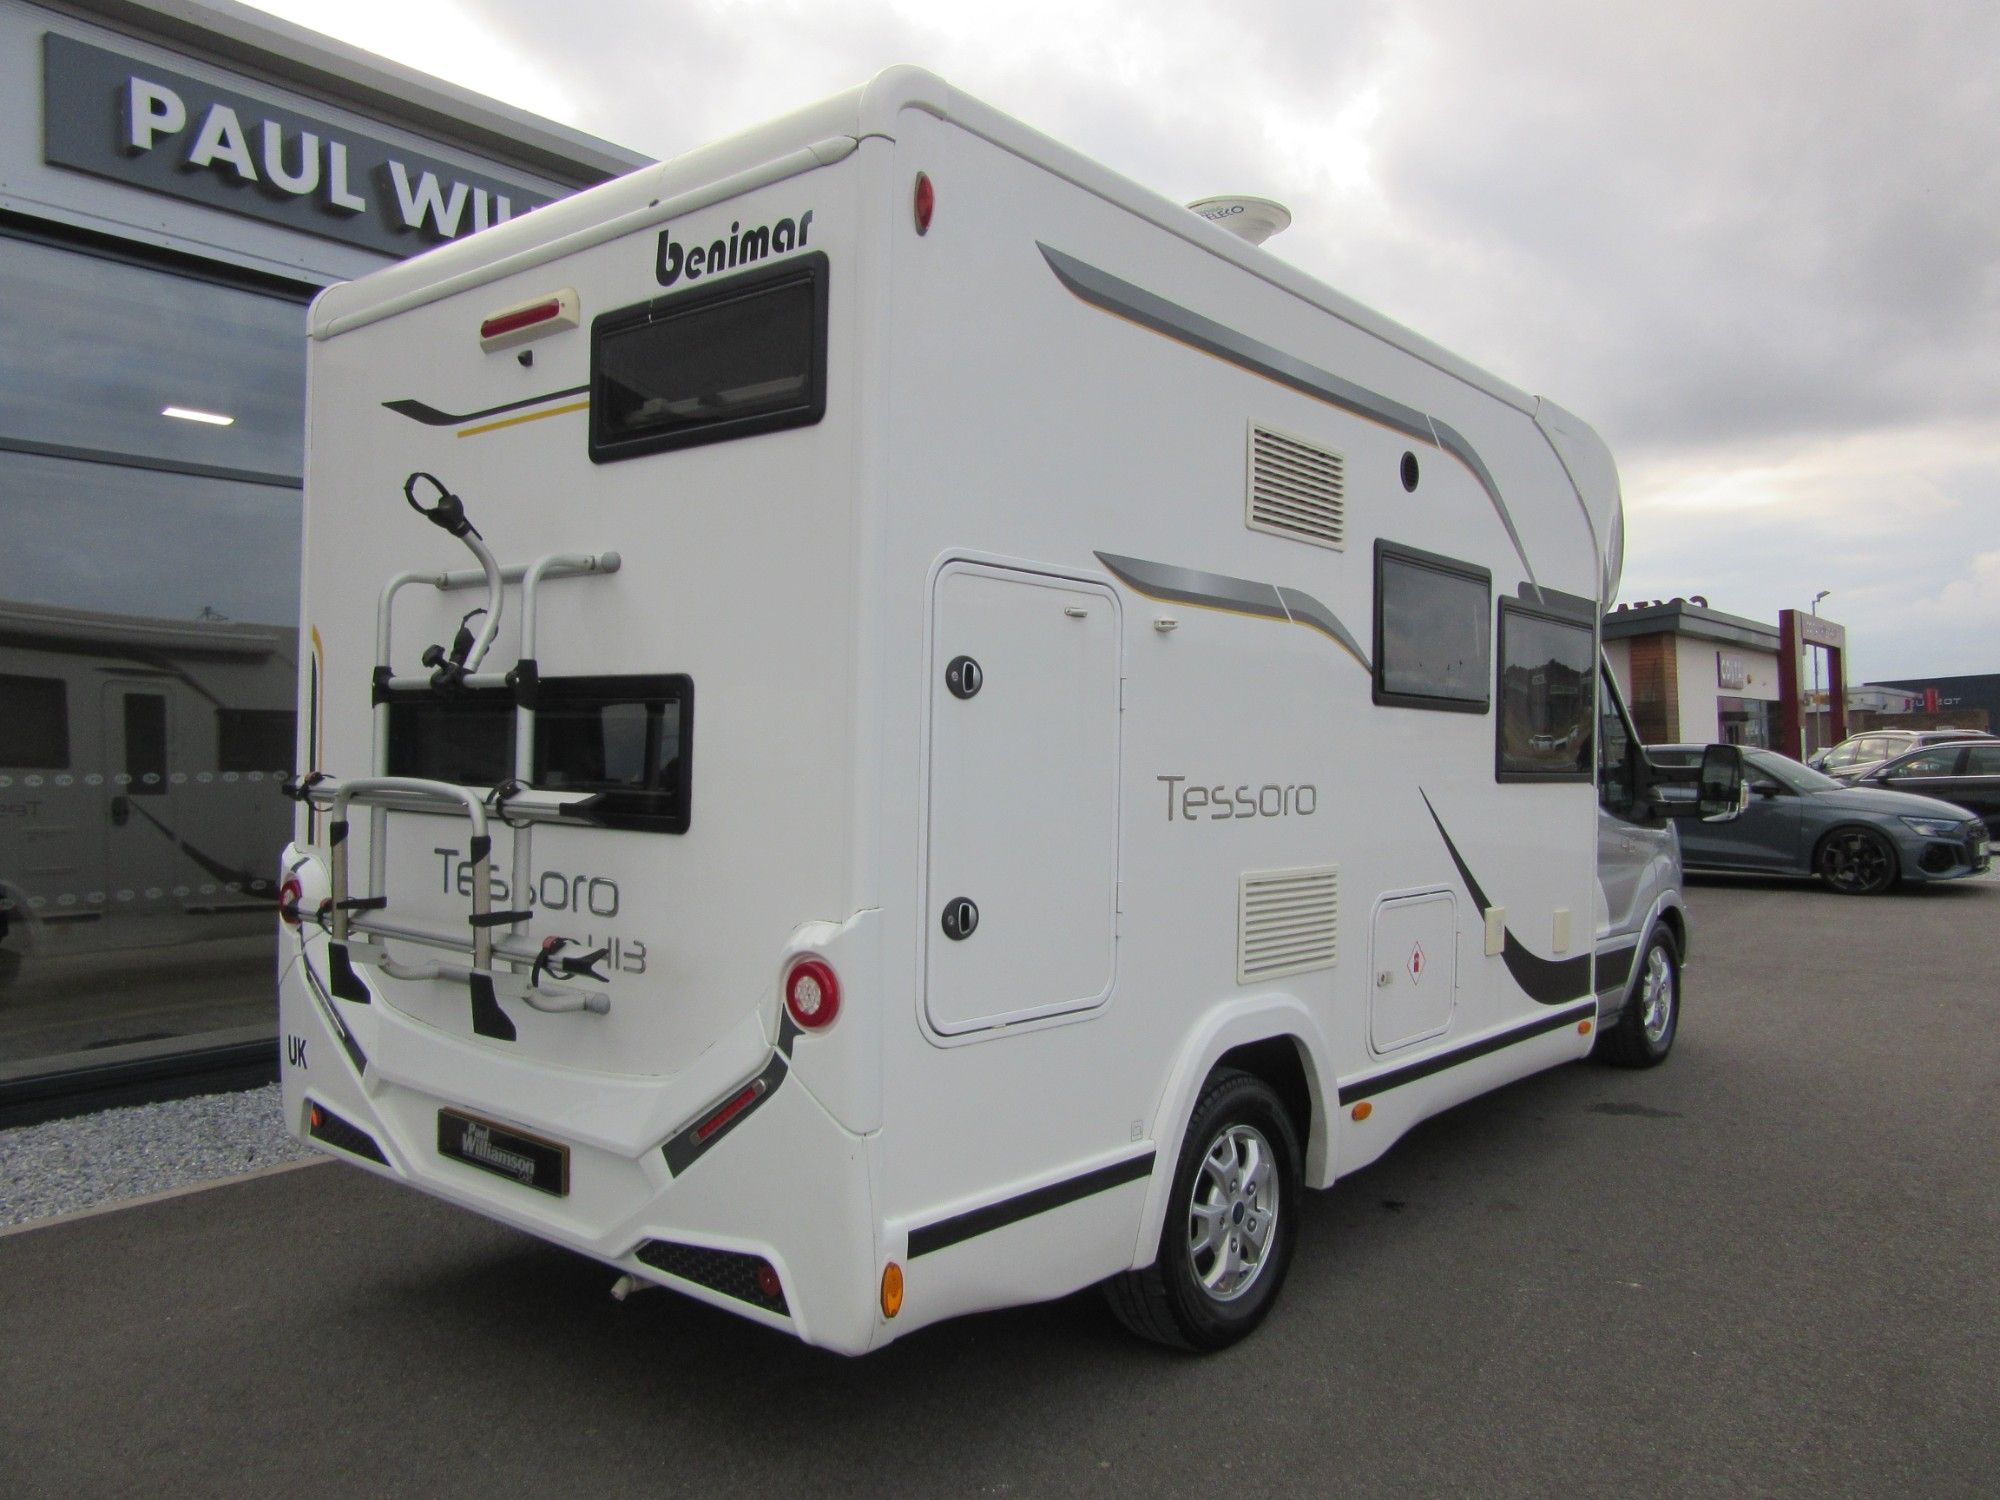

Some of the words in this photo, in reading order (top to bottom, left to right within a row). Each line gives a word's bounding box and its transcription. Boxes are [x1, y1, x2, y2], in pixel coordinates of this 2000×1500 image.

[127, 75, 366, 213] PAUL
[387, 159, 540, 238] WI
[655, 209, 813, 287] benimar
[1156, 775, 1317, 822] Tessoro
[434, 847, 620, 918] Tesoro
[288, 1034, 308, 1070] UK
[462, 1132, 535, 1175] Williamson
